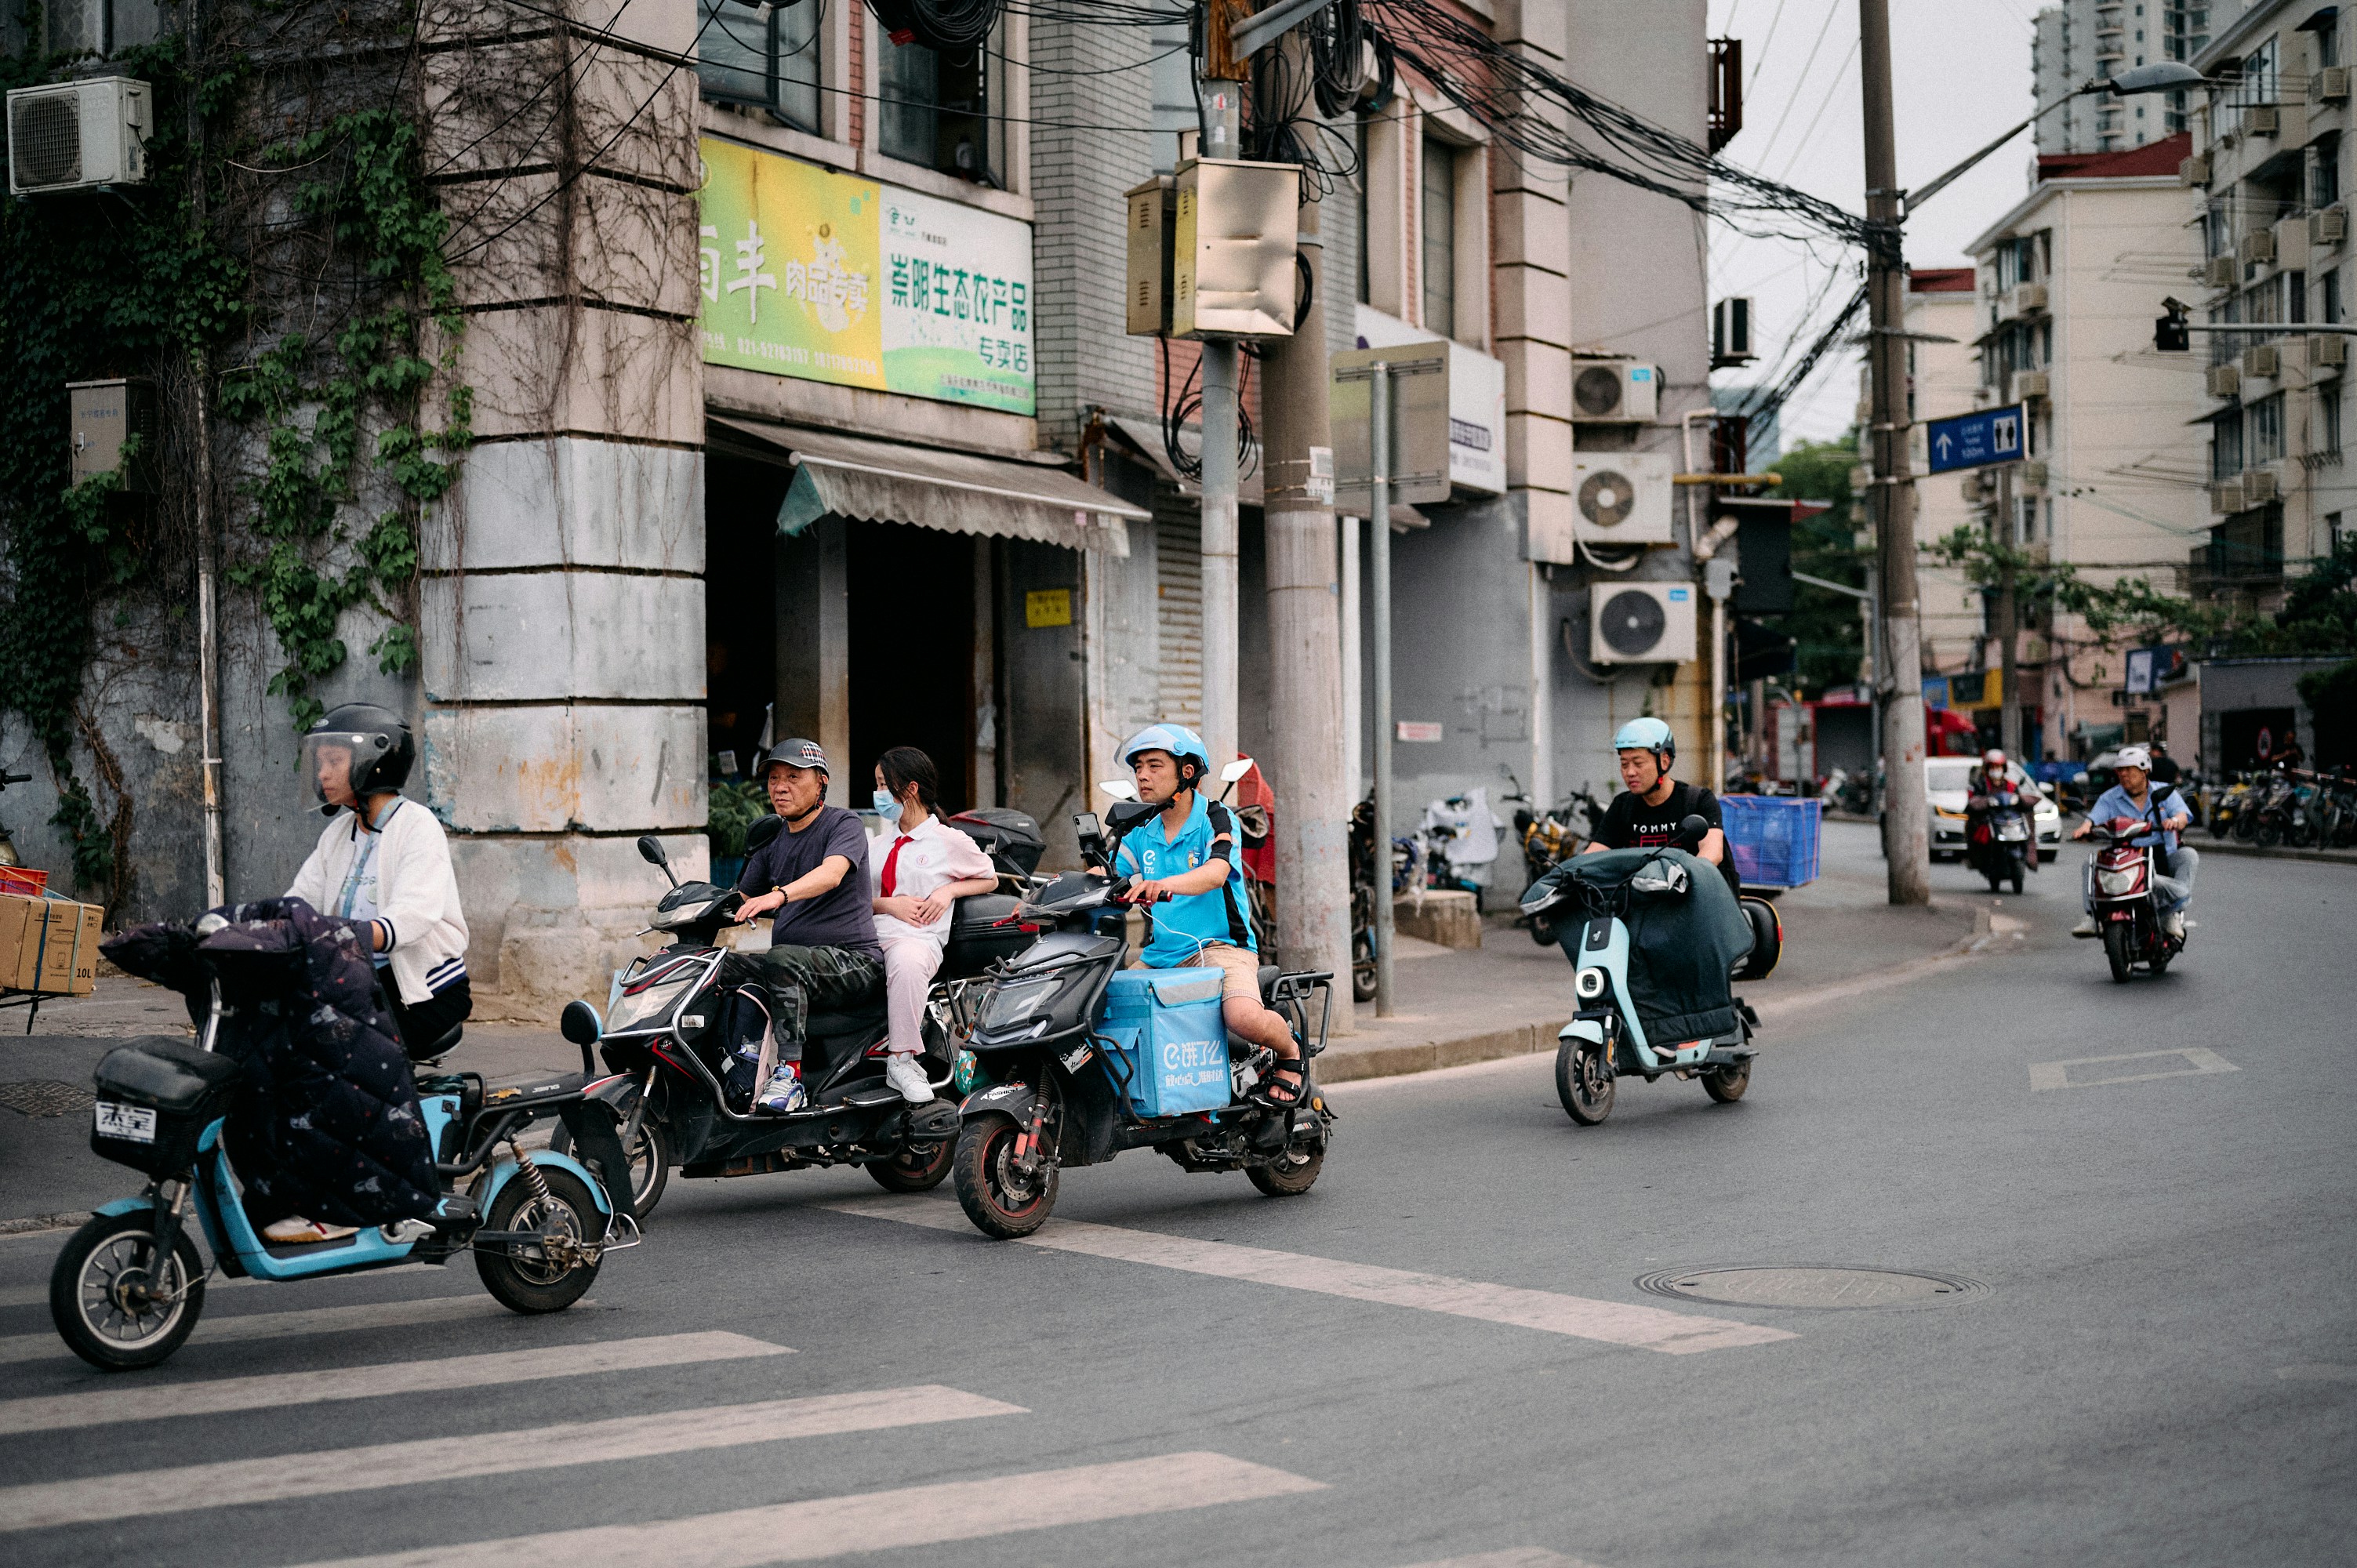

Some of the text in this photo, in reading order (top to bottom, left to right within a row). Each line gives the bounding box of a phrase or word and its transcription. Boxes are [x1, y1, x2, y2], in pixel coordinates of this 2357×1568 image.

[786, 259, 869, 312] 肉品专卖
[892, 253, 1026, 332] 崇明生态农产品
[979, 336, 1028, 372] 专卖店
[1633, 822, 1676, 833] TOMMY
[77, 968, 91, 978] 10L
[986, 1087, 1019, 1100] FASHION
